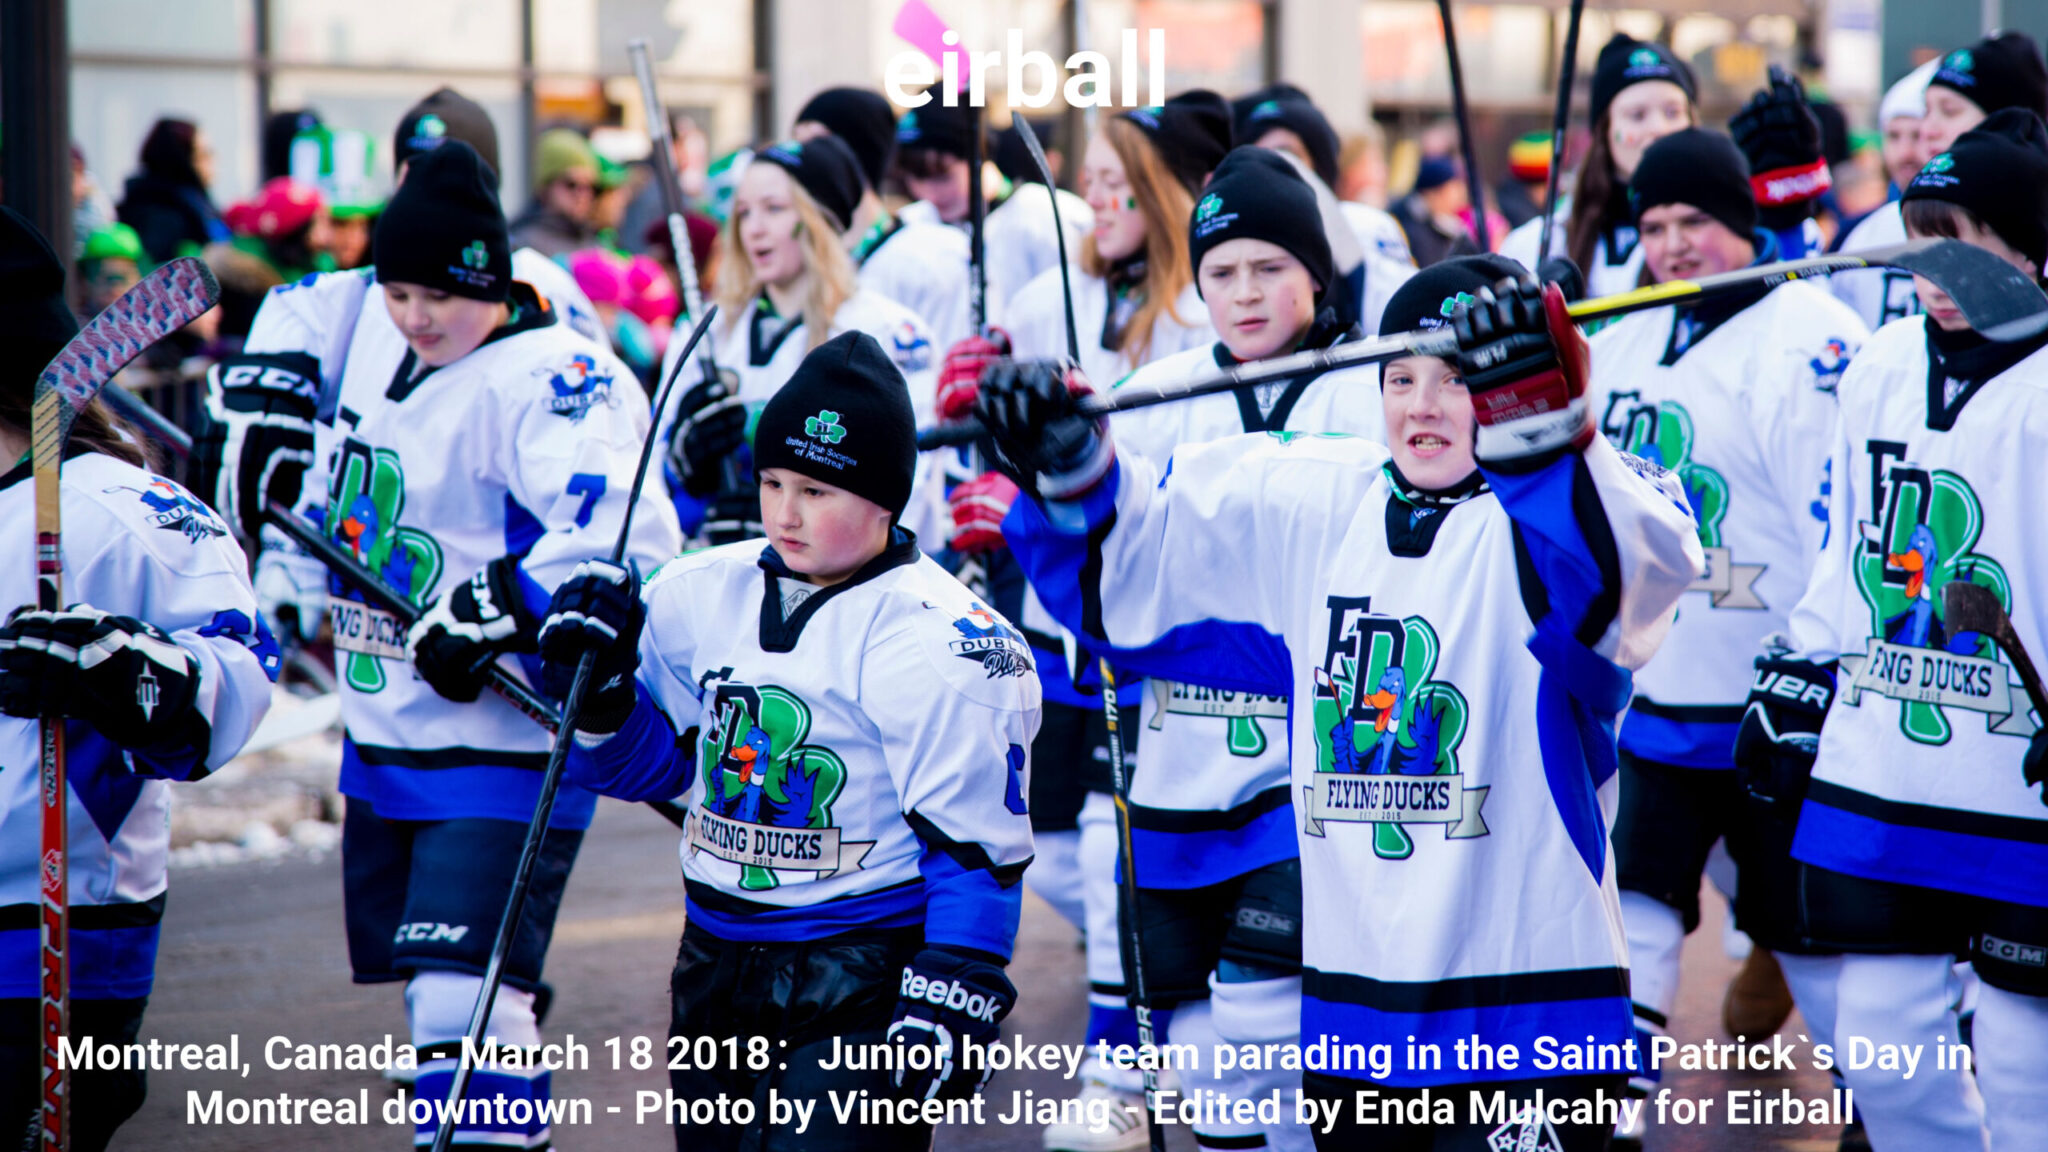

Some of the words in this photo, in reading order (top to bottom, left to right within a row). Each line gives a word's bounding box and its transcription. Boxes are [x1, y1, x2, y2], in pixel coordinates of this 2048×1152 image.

[794, 447, 805, 457] of
[805, 449, 846, 470] Montreal
[809, 441, 826, 454] Irish
[566, 472, 607, 529] 7
[1920, 656, 1993, 698] DUCKS
[1326, 778, 1380, 810] FLYING
[1382, 780, 1451, 811] DUCKS
[701, 814, 748, 853] FLYING
[753, 829, 822, 860] DUCKS
[753, 856, 773, 866] 2015
[1983, 936, 2046, 967] CCM
[900, 966, 1002, 1023] Reebok
